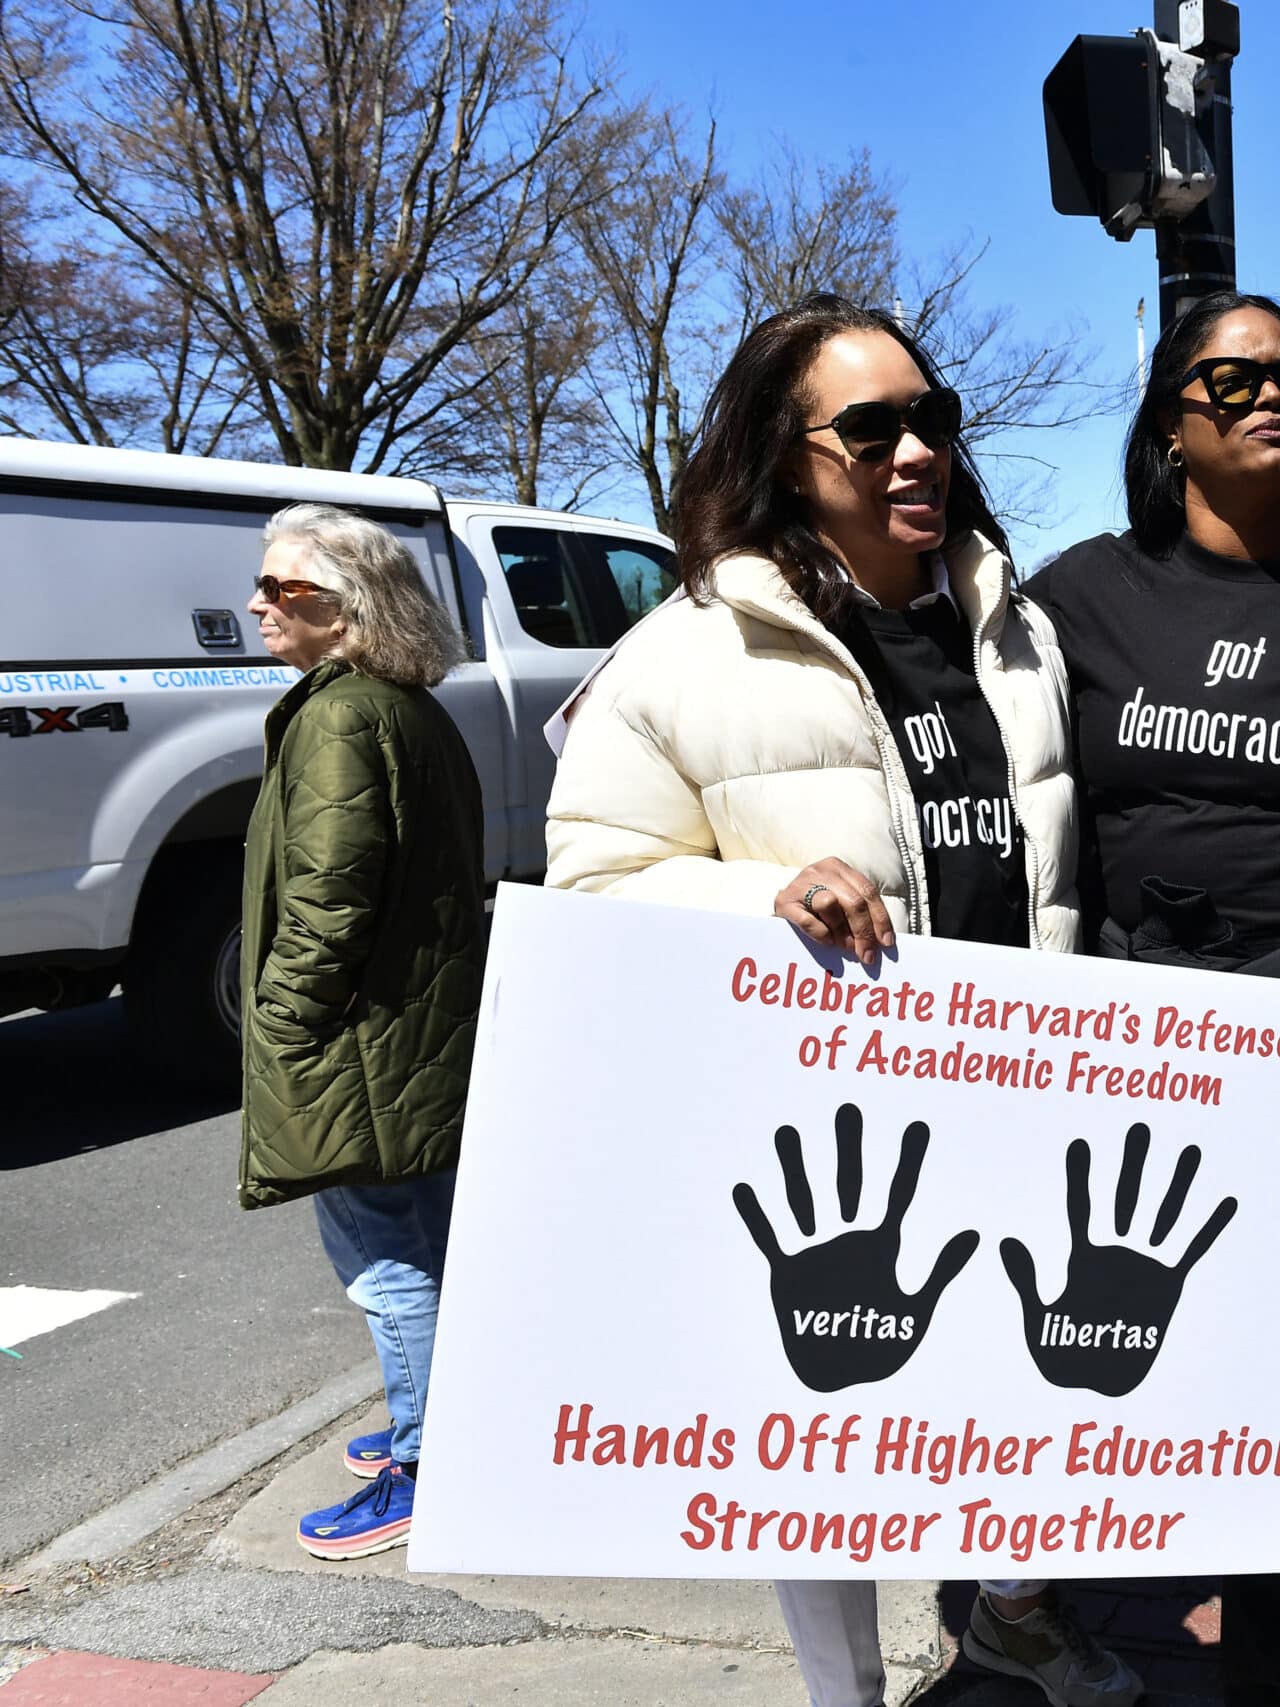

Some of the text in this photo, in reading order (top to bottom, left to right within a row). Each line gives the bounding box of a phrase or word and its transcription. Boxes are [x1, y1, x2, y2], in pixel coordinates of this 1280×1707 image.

[152, 669, 293, 689] COMMERCIAL
[1204, 637, 1266, 687] got
[732, 957, 934, 1022] Celebrate
[948, 982, 1140, 1044] Harvard's
[800, 1025, 1223, 1105] of Academic Freedom
[793, 1304, 915, 1341] veritas
[1040, 1313, 1158, 1350] libertas
[553, 1404, 735, 1469] Hands
[758, 1413, 861, 1472] Off
[875, 1417, 1053, 1484] Higher
[680, 1492, 1185, 1562] Stronger Together
